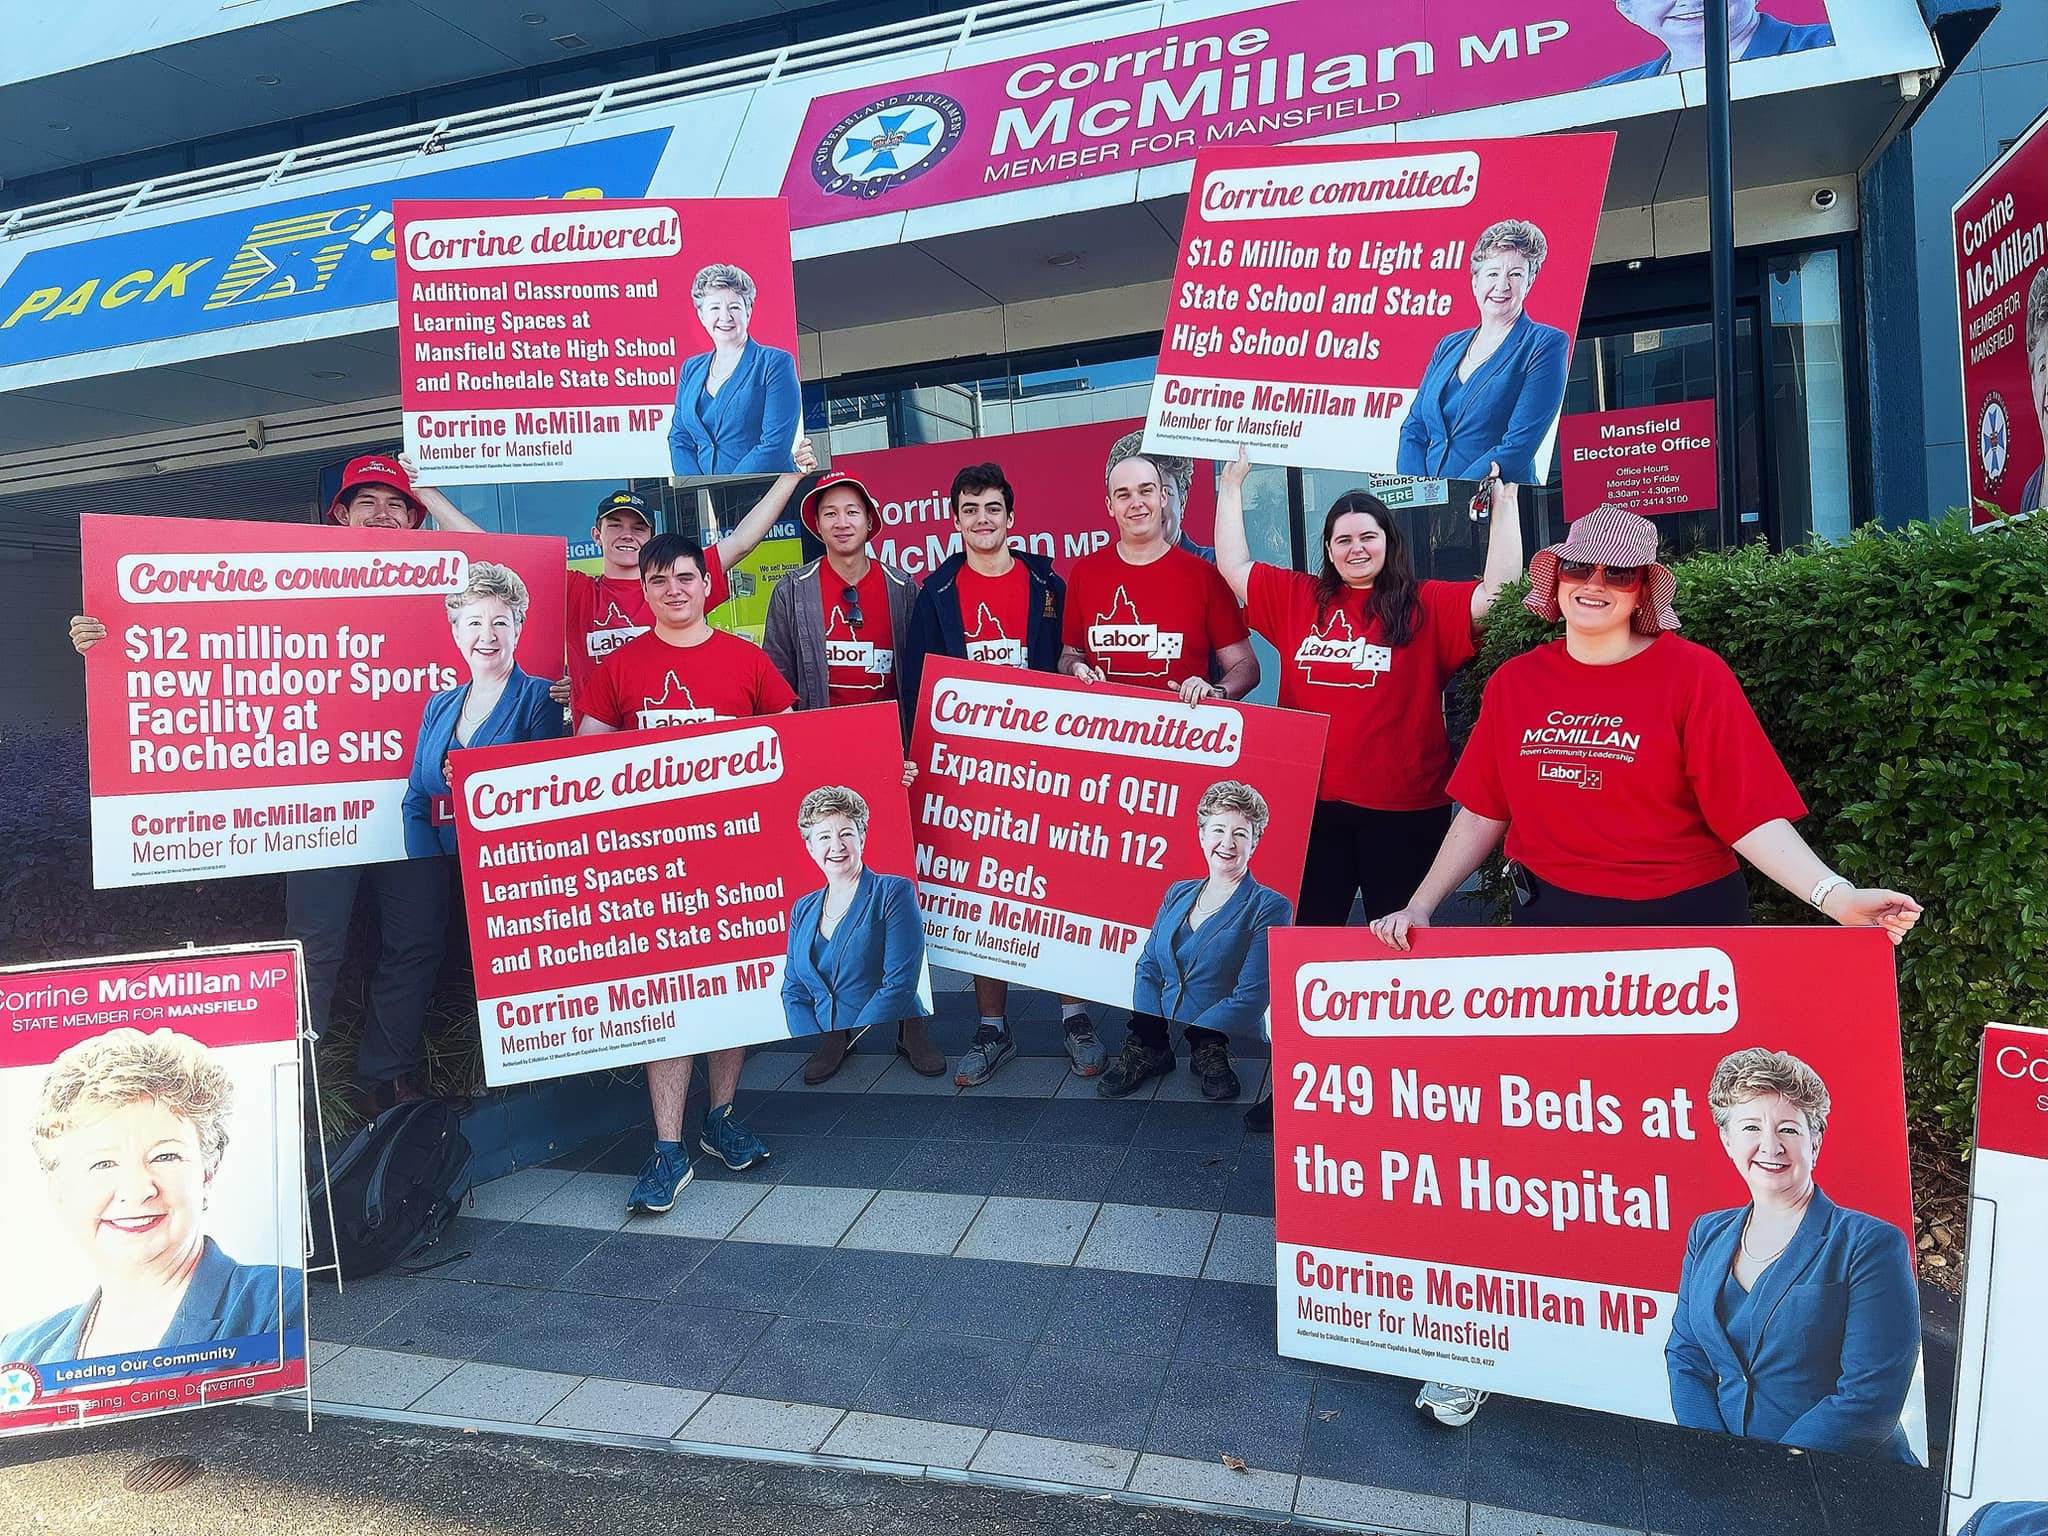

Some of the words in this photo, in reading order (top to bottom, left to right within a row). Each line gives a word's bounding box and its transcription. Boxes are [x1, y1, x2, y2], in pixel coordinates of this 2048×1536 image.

[1004, 27, 1270, 101] Corrine
[989, 38, 1435, 157] McMillan
[1459, 20, 1571, 69] MP
[816, 97, 898, 164] QUEENSLAND
[907, 94, 962, 138] PARLIAMENT
[983, 143, 1120, 183] MEMBER
[1130, 127, 1196, 158] FOR
[1206, 92, 1402, 142] MANSFIELD
[1204, 181, 1304, 211] Corrine
[1309, 166, 1475, 205] committed:
[409, 230, 525, 260] Corrine
[530, 218, 678, 254] delivered!
[1963, 192, 2014, 257] Corrine
[1186, 236, 1233, 269] $1.6
[1239, 240, 1319, 269] Million
[1327, 242, 1351, 269] to
[1359, 241, 1423, 276] Light
[1430, 240, 1466, 270] all
[1965, 222, 2045, 309] McMillan
[1, 258, 213, 328] PACK
[412, 282, 507, 302] Additional
[513, 281, 619, 300] Classrooms
[625, 278, 658, 298] and
[1179, 281, 1239, 310] State
[1246, 283, 1326, 314] School
[1332, 286, 1380, 315] and
[1384, 286, 1453, 316] State
[413, 312, 496, 335] Learning
[501, 311, 566, 333] Spaces
[572, 311, 592, 328] at
[1969, 303, 2004, 341] MEMBER
[2004, 291, 2021, 319] FOR
[414, 342, 506, 362] Mansfield
[511, 341, 561, 360] State
[566, 339, 609, 361] High
[615, 337, 676, 357] School
[1170, 324, 1222, 358] High
[1229, 326, 1310, 357] School
[1315, 330, 1381, 360] Ovals
[1971, 323, 2015, 366] MANSFIELD
[416, 372, 450, 392] and
[456, 369, 555, 391] Rochedale
[560, 369, 609, 388] State
[615, 366, 676, 386] School
[1164, 379, 1245, 409] Corrine
[1252, 385, 1357, 417] McMillan
[1363, 391, 1403, 419] MP
[417, 414, 507, 439] Corrine
[515, 410, 620, 435] McMillan
[629, 408, 664, 432] MP
[1600, 418, 1680, 439] Mansfield
[419, 443, 475, 460] Member
[481, 443, 501, 457] for
[505, 440, 573, 457] Mansfield
[1573, 442, 1656, 462] Electorate
[1661, 437, 1711, 452] Office
[1370, 476, 1414, 488] SENIORS
[1606, 477, 1640, 488] Monday
[1654, 474, 1680, 484] Friday
[1616, 467, 1641, 476] Office
[1643, 464, 1670, 473] Hours
[1380, 490, 1413, 504] HERE
[1608, 489, 1640, 499] 8.30am
[1647, 486, 1680, 496] 4.30pm
[1630, 500, 1640, 508] 07
[1643, 497, 1664, 506] 3414
[1666, 495, 1688, 504] 3100
[1064, 530, 1110, 559] MP
[130, 561, 269, 594] Corrine
[275, 557, 461, 588] committed!
[124, 624, 189, 663] $12
[199, 625, 328, 660] million
[336, 625, 385, 659] for
[1092, 630, 1150, 647] Labor
[1301, 641, 1356, 658] Labor
[127, 670, 213, 698] new
[222, 662, 342, 697] Indoor
[350, 662, 458, 700] Sports
[129, 699, 274, 740] Facility
[282, 700, 319, 731] at
[934, 690, 1049, 732] Corrine
[1054, 712, 1238, 754] committed:
[1547, 710, 1624, 728] Corrine
[129, 733, 330, 774] Rochedale
[338, 729, 403, 764] SHS
[1520, 748, 1542, 756] Proven
[1542, 748, 1588, 758] Community
[1588, 750, 1634, 763] Leadership
[1522, 728, 1640, 750] MCMILLAN
[472, 775, 604, 820] Corrine
[611, 736, 778, 797] delivered!
[929, 742, 1071, 799] Expansion
[1079, 773, 1112, 805] of
[1118, 776, 1181, 819] QEII
[1541, 764, 1581, 780] Labor
[131, 810, 227, 836] Corrine
[233, 802, 336, 828] McMillan
[342, 798, 375, 820] MP
[920, 793, 1041, 846] Hospital
[1049, 821, 1111, 860] with
[1120, 831, 1170, 871] 112
[915, 843, 971, 885] New
[977, 855, 1048, 901] Beds
[919, 892, 982, 922] orrine
[989, 900, 1092, 946] McMillan
[1099, 924, 1138, 954] MP
[98, 972, 240, 1004] McMillan
[249, 968, 287, 990] MP
[496, 993, 599, 1029] Corrine
[608, 972, 728, 1012] McMillan
[736, 961, 776, 992] MP
[1302, 977, 1455, 1022] Corrine
[1463, 969, 1730, 1020] committed:
[12, 1016, 59, 1033] STATE
[62, 1009, 129, 1027] MEMBER
[133, 1007, 164, 1020] FOR
[167, 998, 258, 1018] MANSFIELD
[1292, 1062, 1374, 1117] 249
[1390, 1067, 1482, 1125] New
[1499, 1073, 1623, 1136] Beds
[1641, 1086, 1697, 1141] at
[1293, 1144, 1365, 1198] the
[1380, 1149, 1442, 1208] PA
[1458, 1156, 1672, 1232] Hospital
[1295, 1250, 1414, 1302] Corrine
[1426, 1267, 1585, 1327] McMillan
[1599, 1290, 1658, 1336] MP
[1298, 1295, 1372, 1330] Member
[1378, 1308, 1405, 1335] for
[1412, 1312, 1510, 1352] Mansfield
[55, 1363, 116, 1382] Leading
[120, 1358, 148, 1373] Our
[152, 1346, 237, 1369] Community
